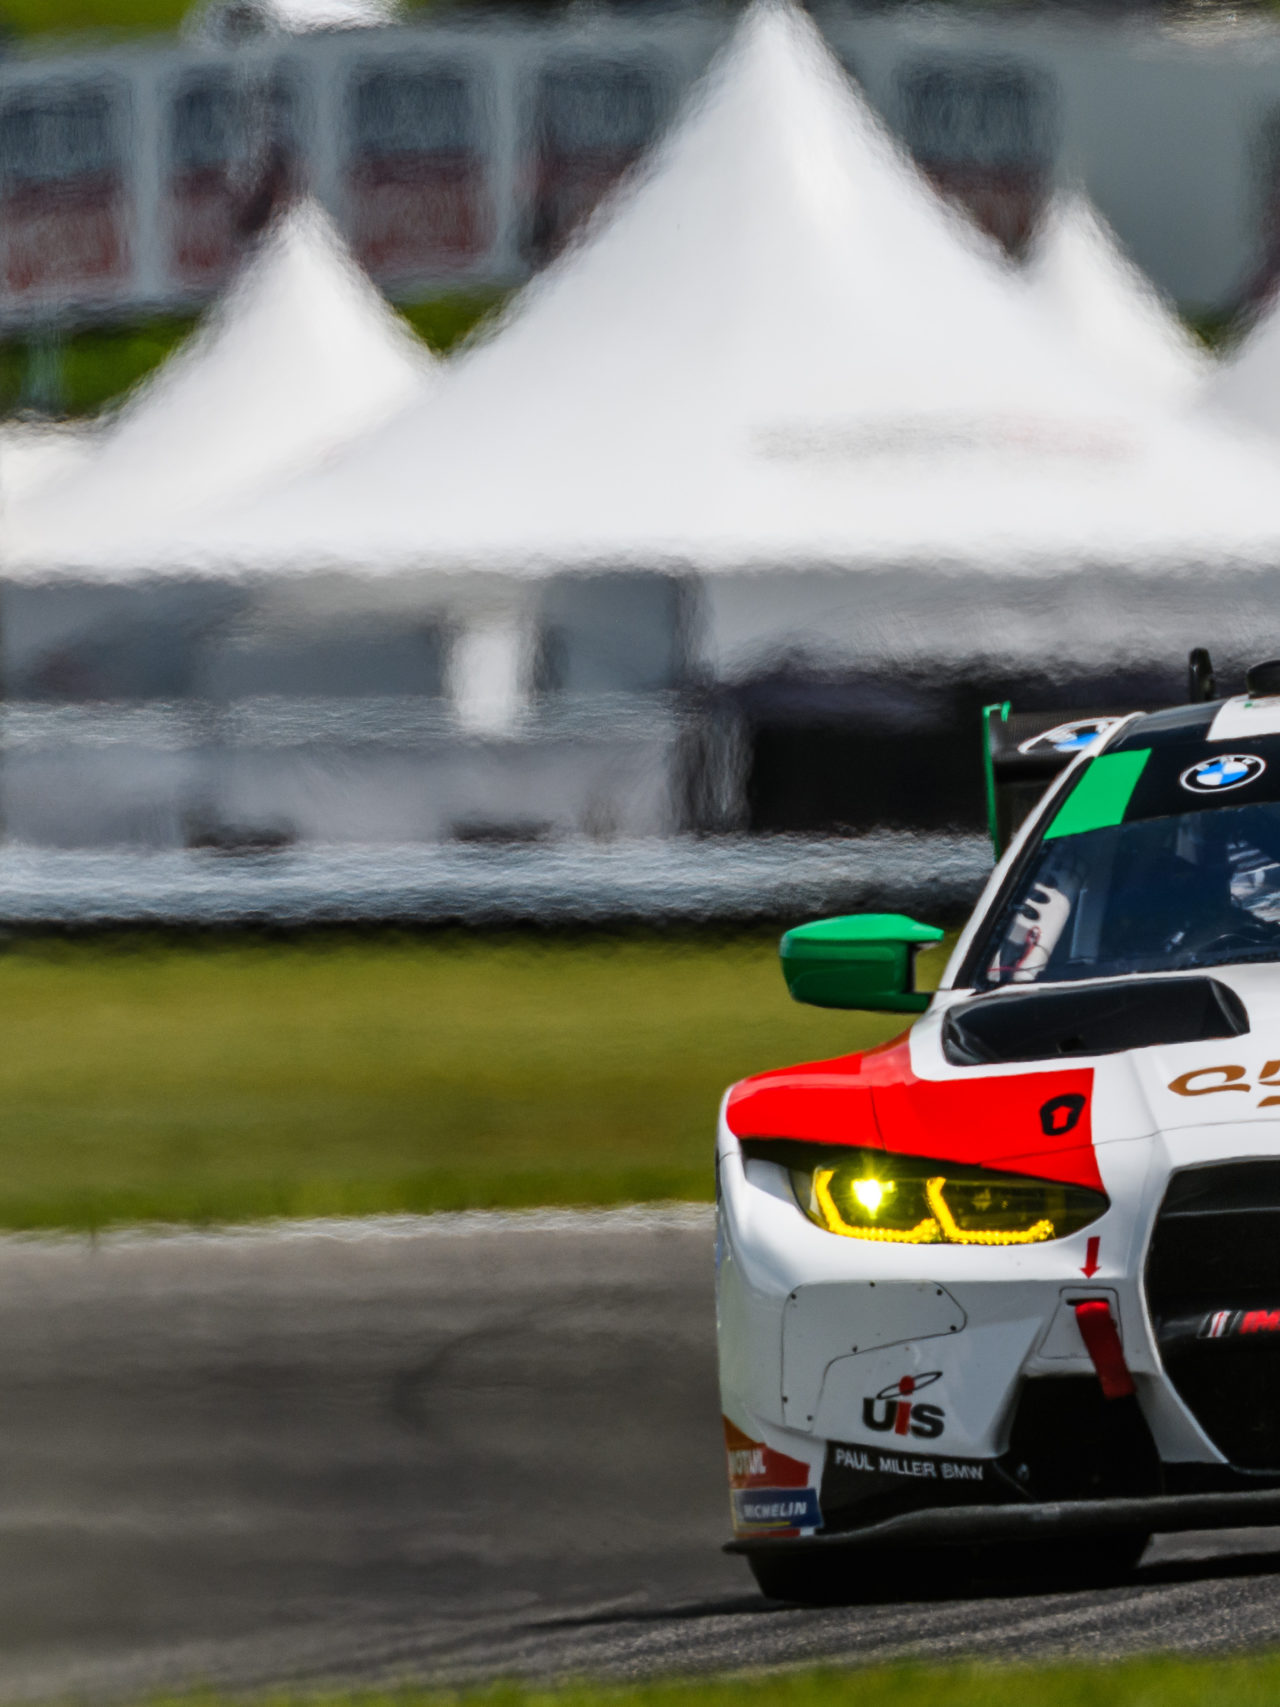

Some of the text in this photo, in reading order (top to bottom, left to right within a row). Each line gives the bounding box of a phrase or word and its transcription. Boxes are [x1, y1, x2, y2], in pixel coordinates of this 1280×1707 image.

[835, 1448, 984, 1480] PAUL MILLER BMW
